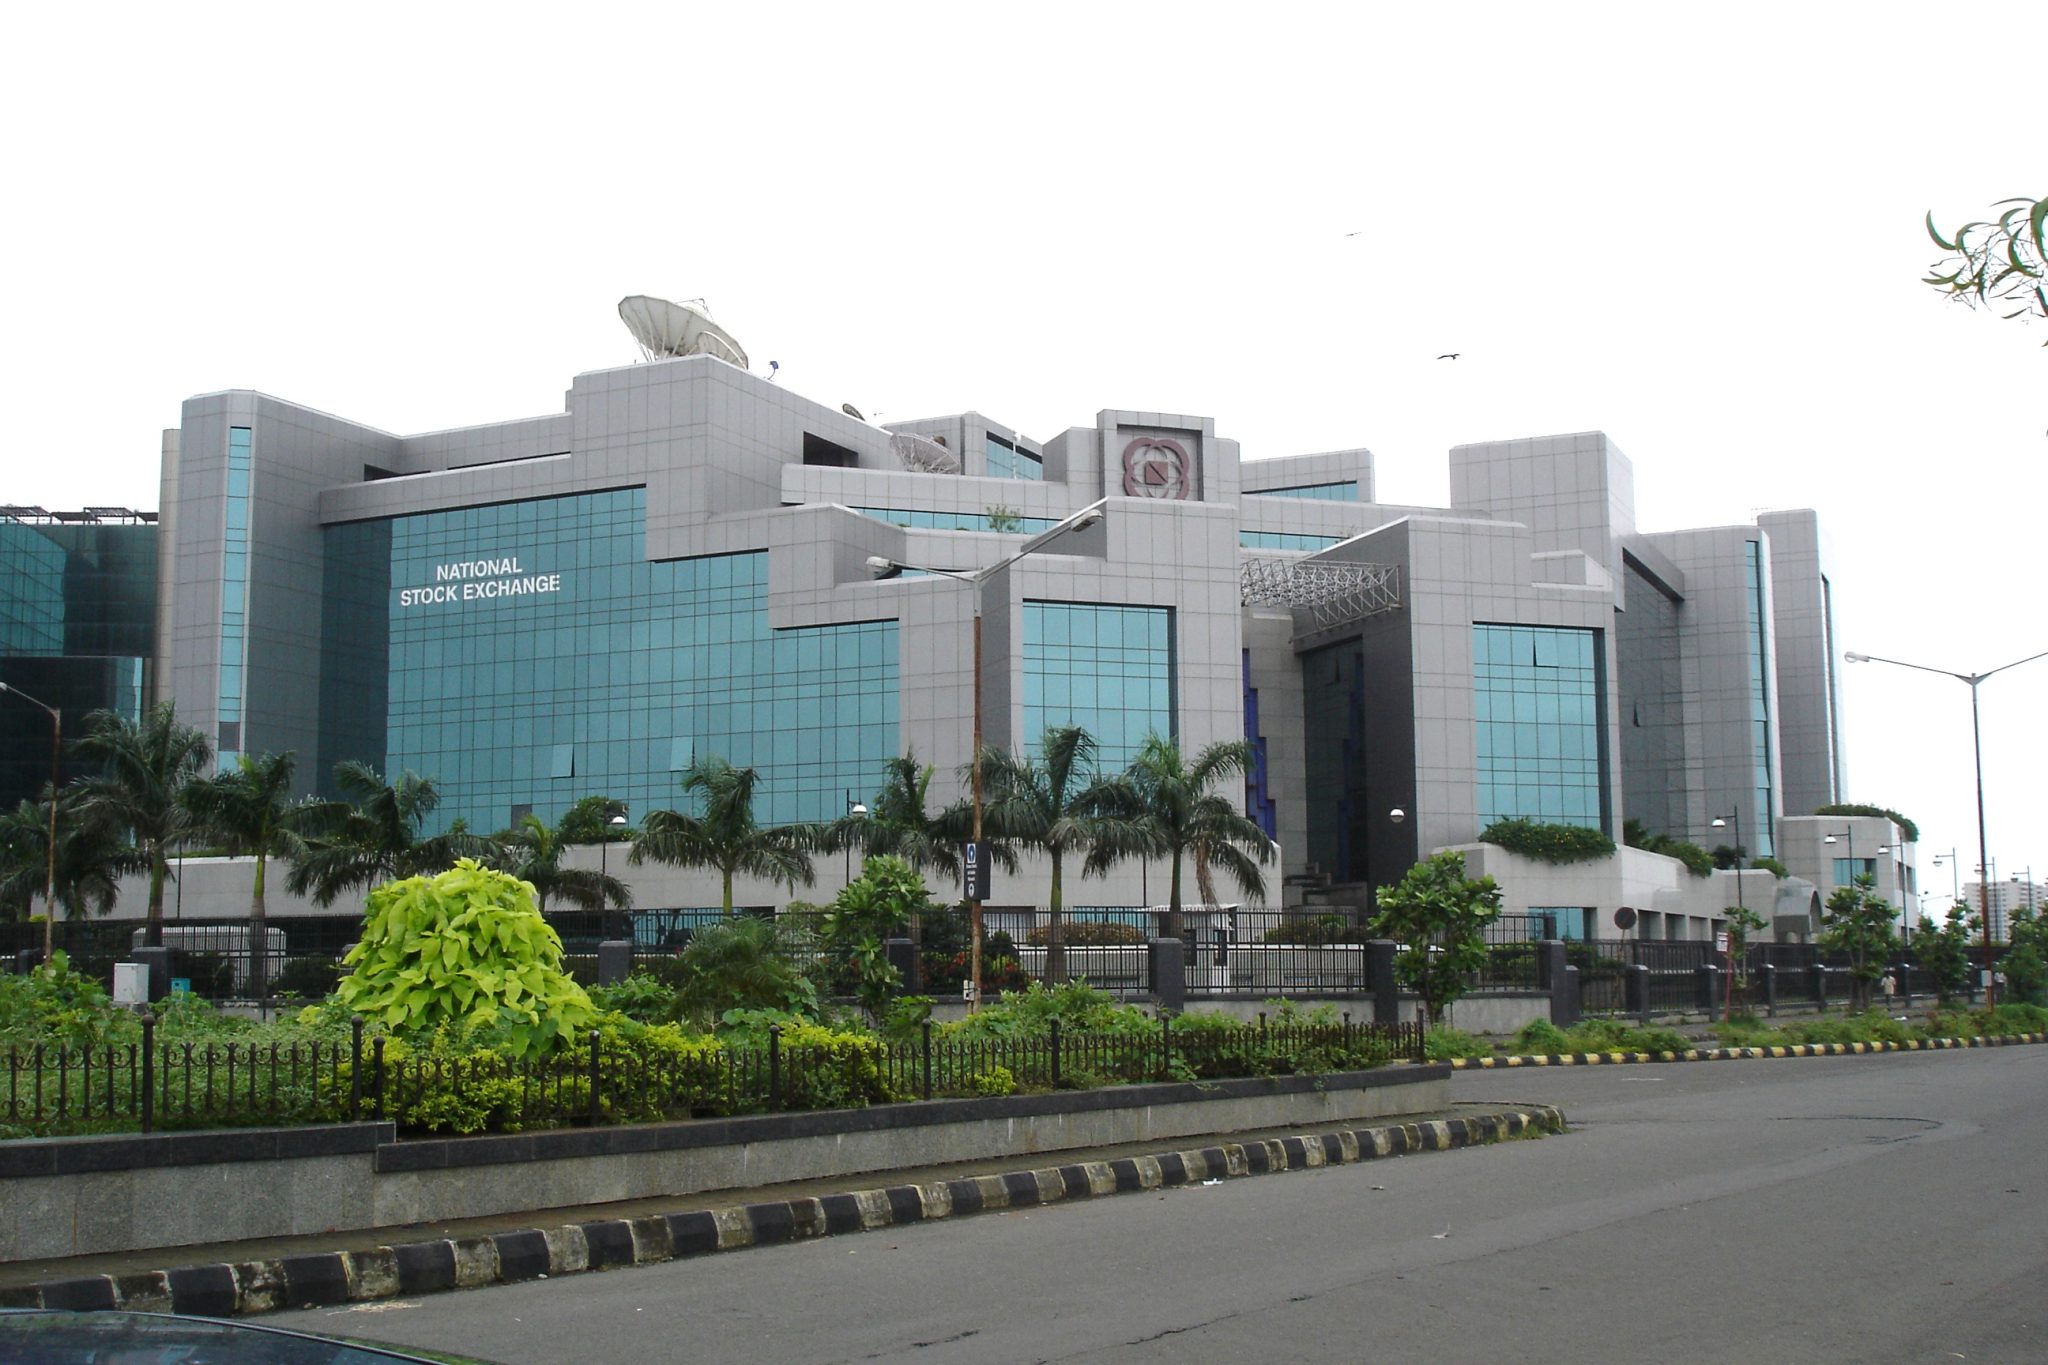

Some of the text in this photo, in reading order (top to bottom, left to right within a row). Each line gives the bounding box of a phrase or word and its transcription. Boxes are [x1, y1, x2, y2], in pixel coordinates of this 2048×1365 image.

[437, 557, 522, 581] NATIONAL
[401, 574, 560, 606] STOCK EXCHANGE
